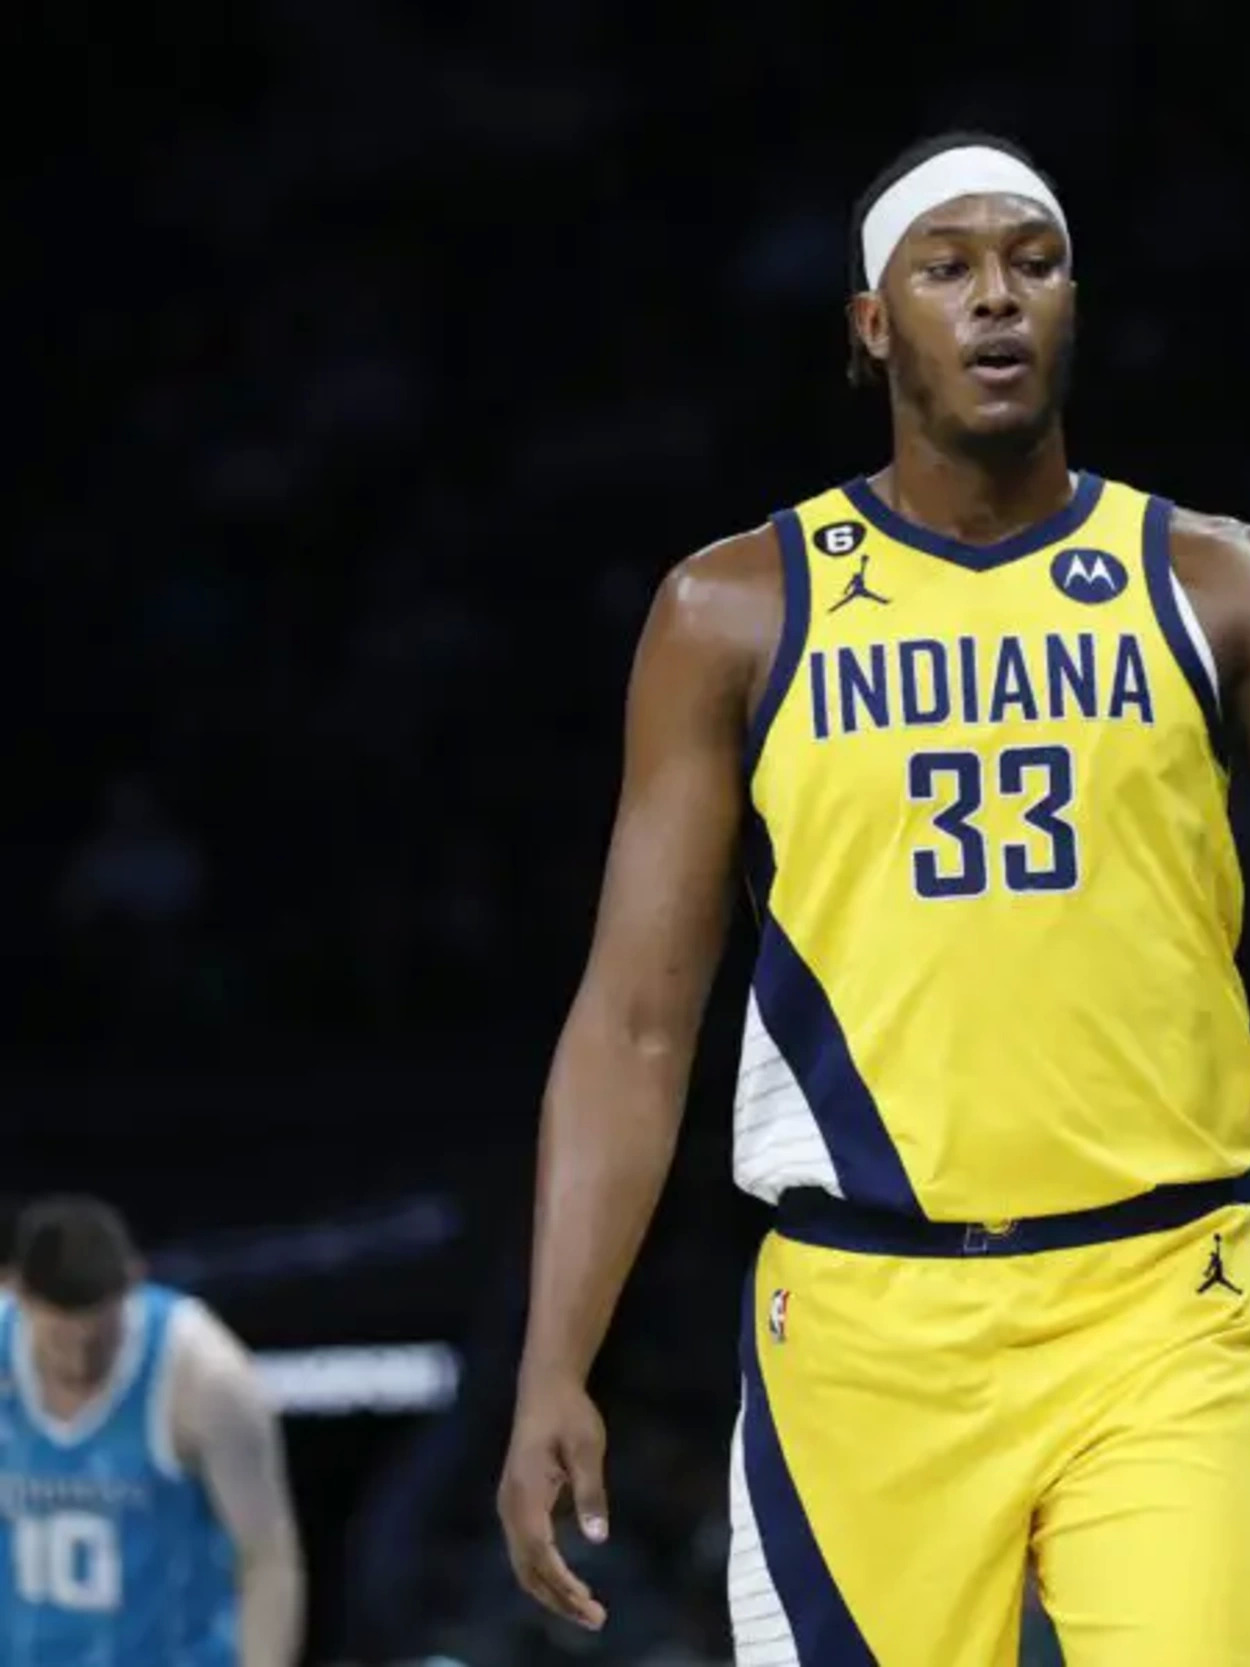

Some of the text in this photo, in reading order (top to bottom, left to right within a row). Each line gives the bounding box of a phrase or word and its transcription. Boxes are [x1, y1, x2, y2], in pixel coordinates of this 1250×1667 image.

[823, 525, 855, 554] 6
[808, 632, 1156, 741] INDIANA
[907, 744, 1079, 900] 33
[14, 1511, 122, 1614] 10
